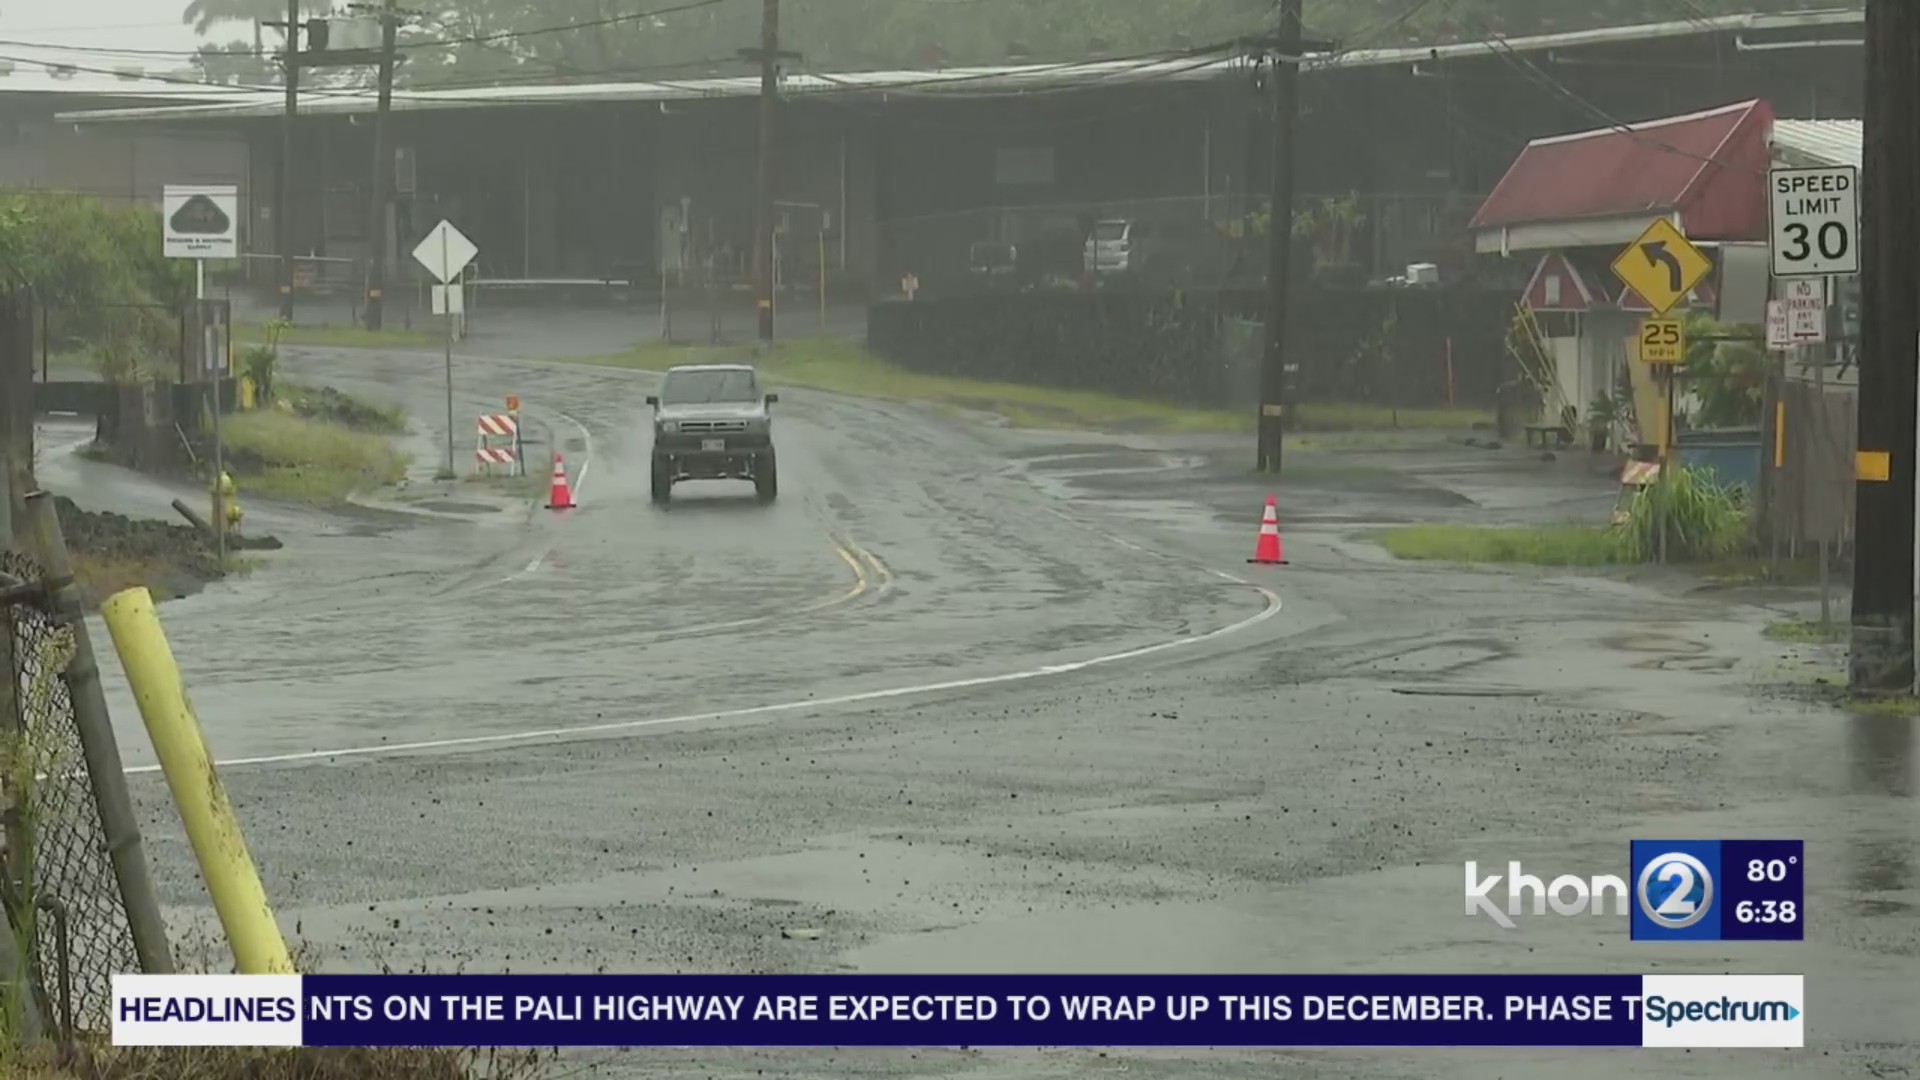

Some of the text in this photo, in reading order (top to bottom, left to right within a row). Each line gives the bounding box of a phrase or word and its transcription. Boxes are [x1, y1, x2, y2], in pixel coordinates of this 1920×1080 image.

[1777, 175, 1849, 193] SPEED
[1786, 197, 1841, 215] LIMIT
[1782, 221, 1848, 261] 30
[1796, 283, 1811, 296] NO
[1788, 298, 1821, 311] PARKING
[1644, 324, 1679, 345] 25
[1648, 347, 1675, 357] MPH
